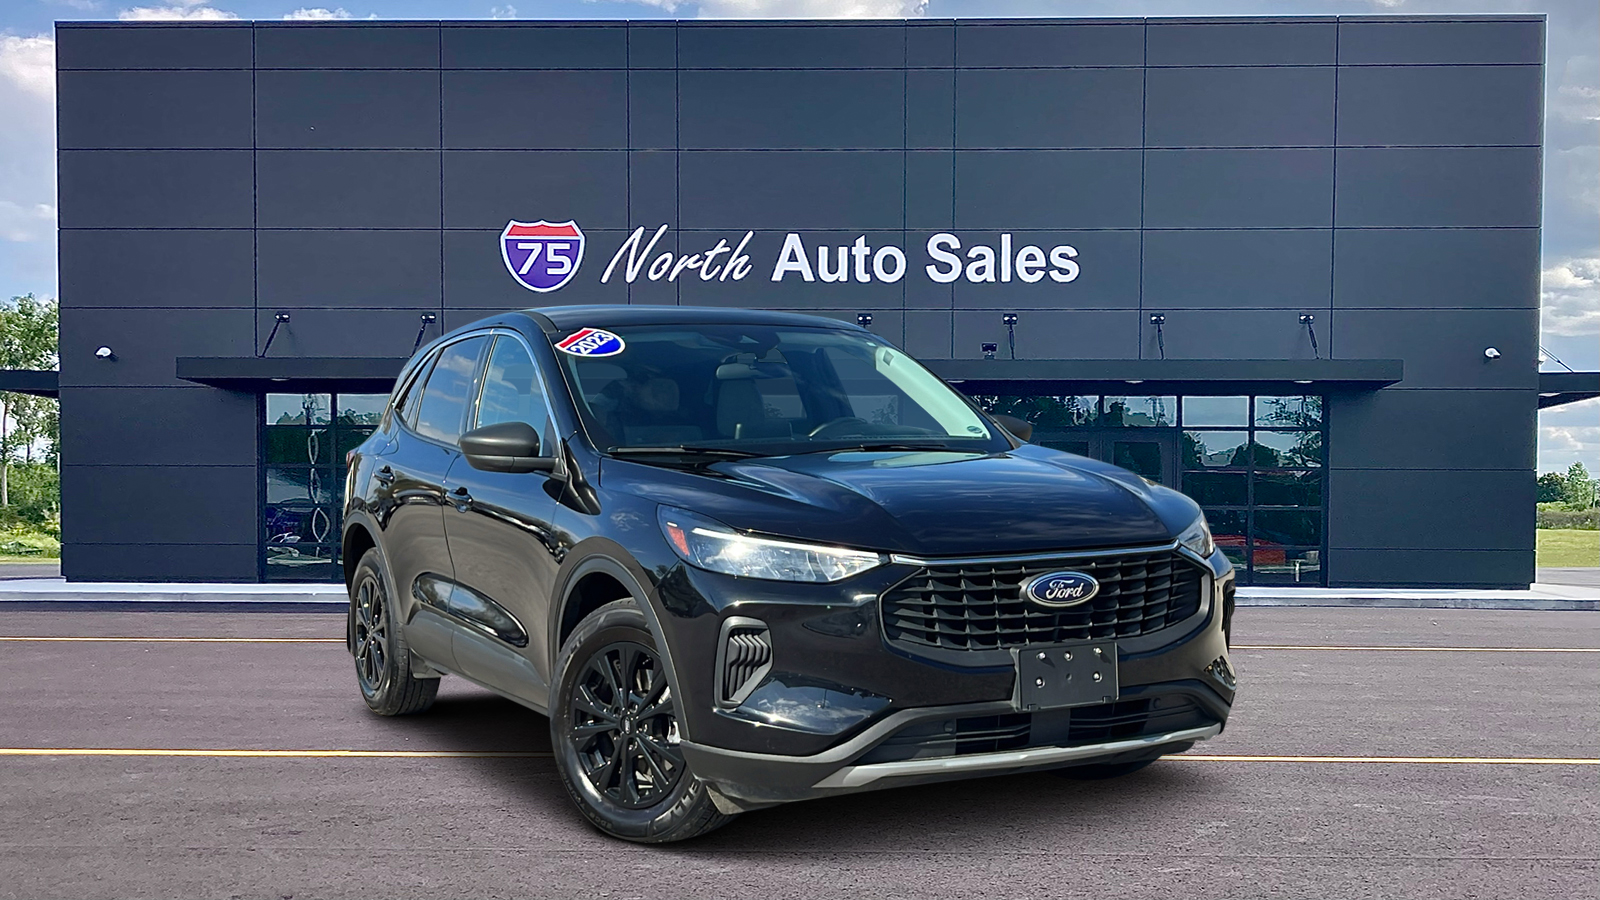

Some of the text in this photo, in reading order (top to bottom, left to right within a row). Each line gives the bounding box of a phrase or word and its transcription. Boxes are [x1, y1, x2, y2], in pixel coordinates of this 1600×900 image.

[517, 224, 1080, 284] 75 North Auto Sales
[569, 332, 614, 355] 2023
[1045, 579, 1084, 599] Ford
